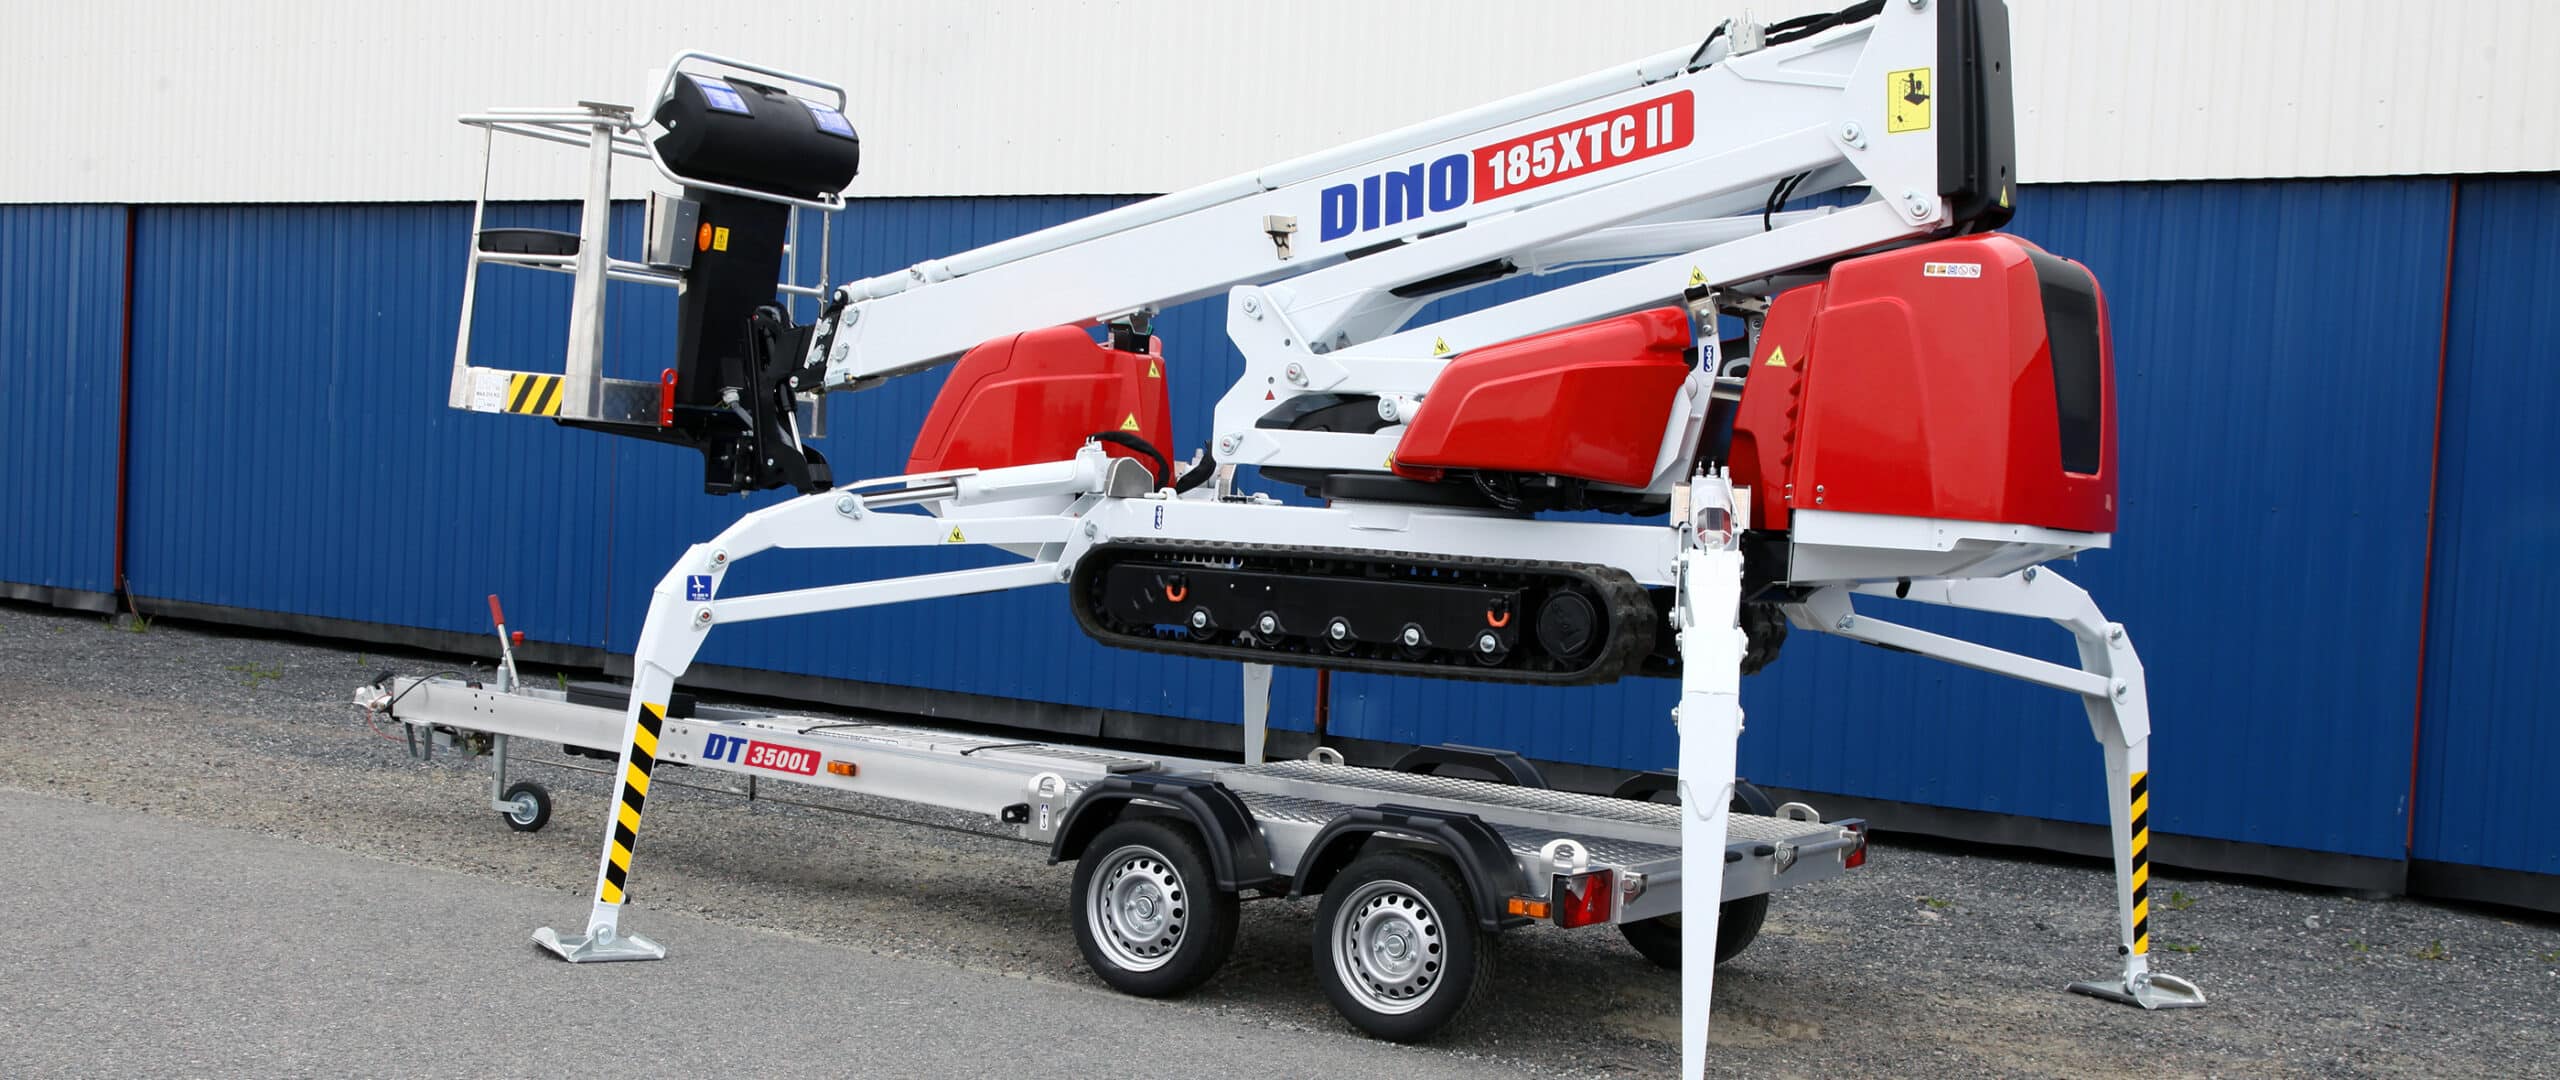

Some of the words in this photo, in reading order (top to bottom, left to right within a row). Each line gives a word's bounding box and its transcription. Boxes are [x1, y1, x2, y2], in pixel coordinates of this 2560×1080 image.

[1320, 153, 1469, 242] DINO
[1488, 115, 1635, 190] 185XTC
[1646, 102, 1673, 148] II
[703, 733, 748, 763] DT
[751, 746, 811, 772] 3500L
